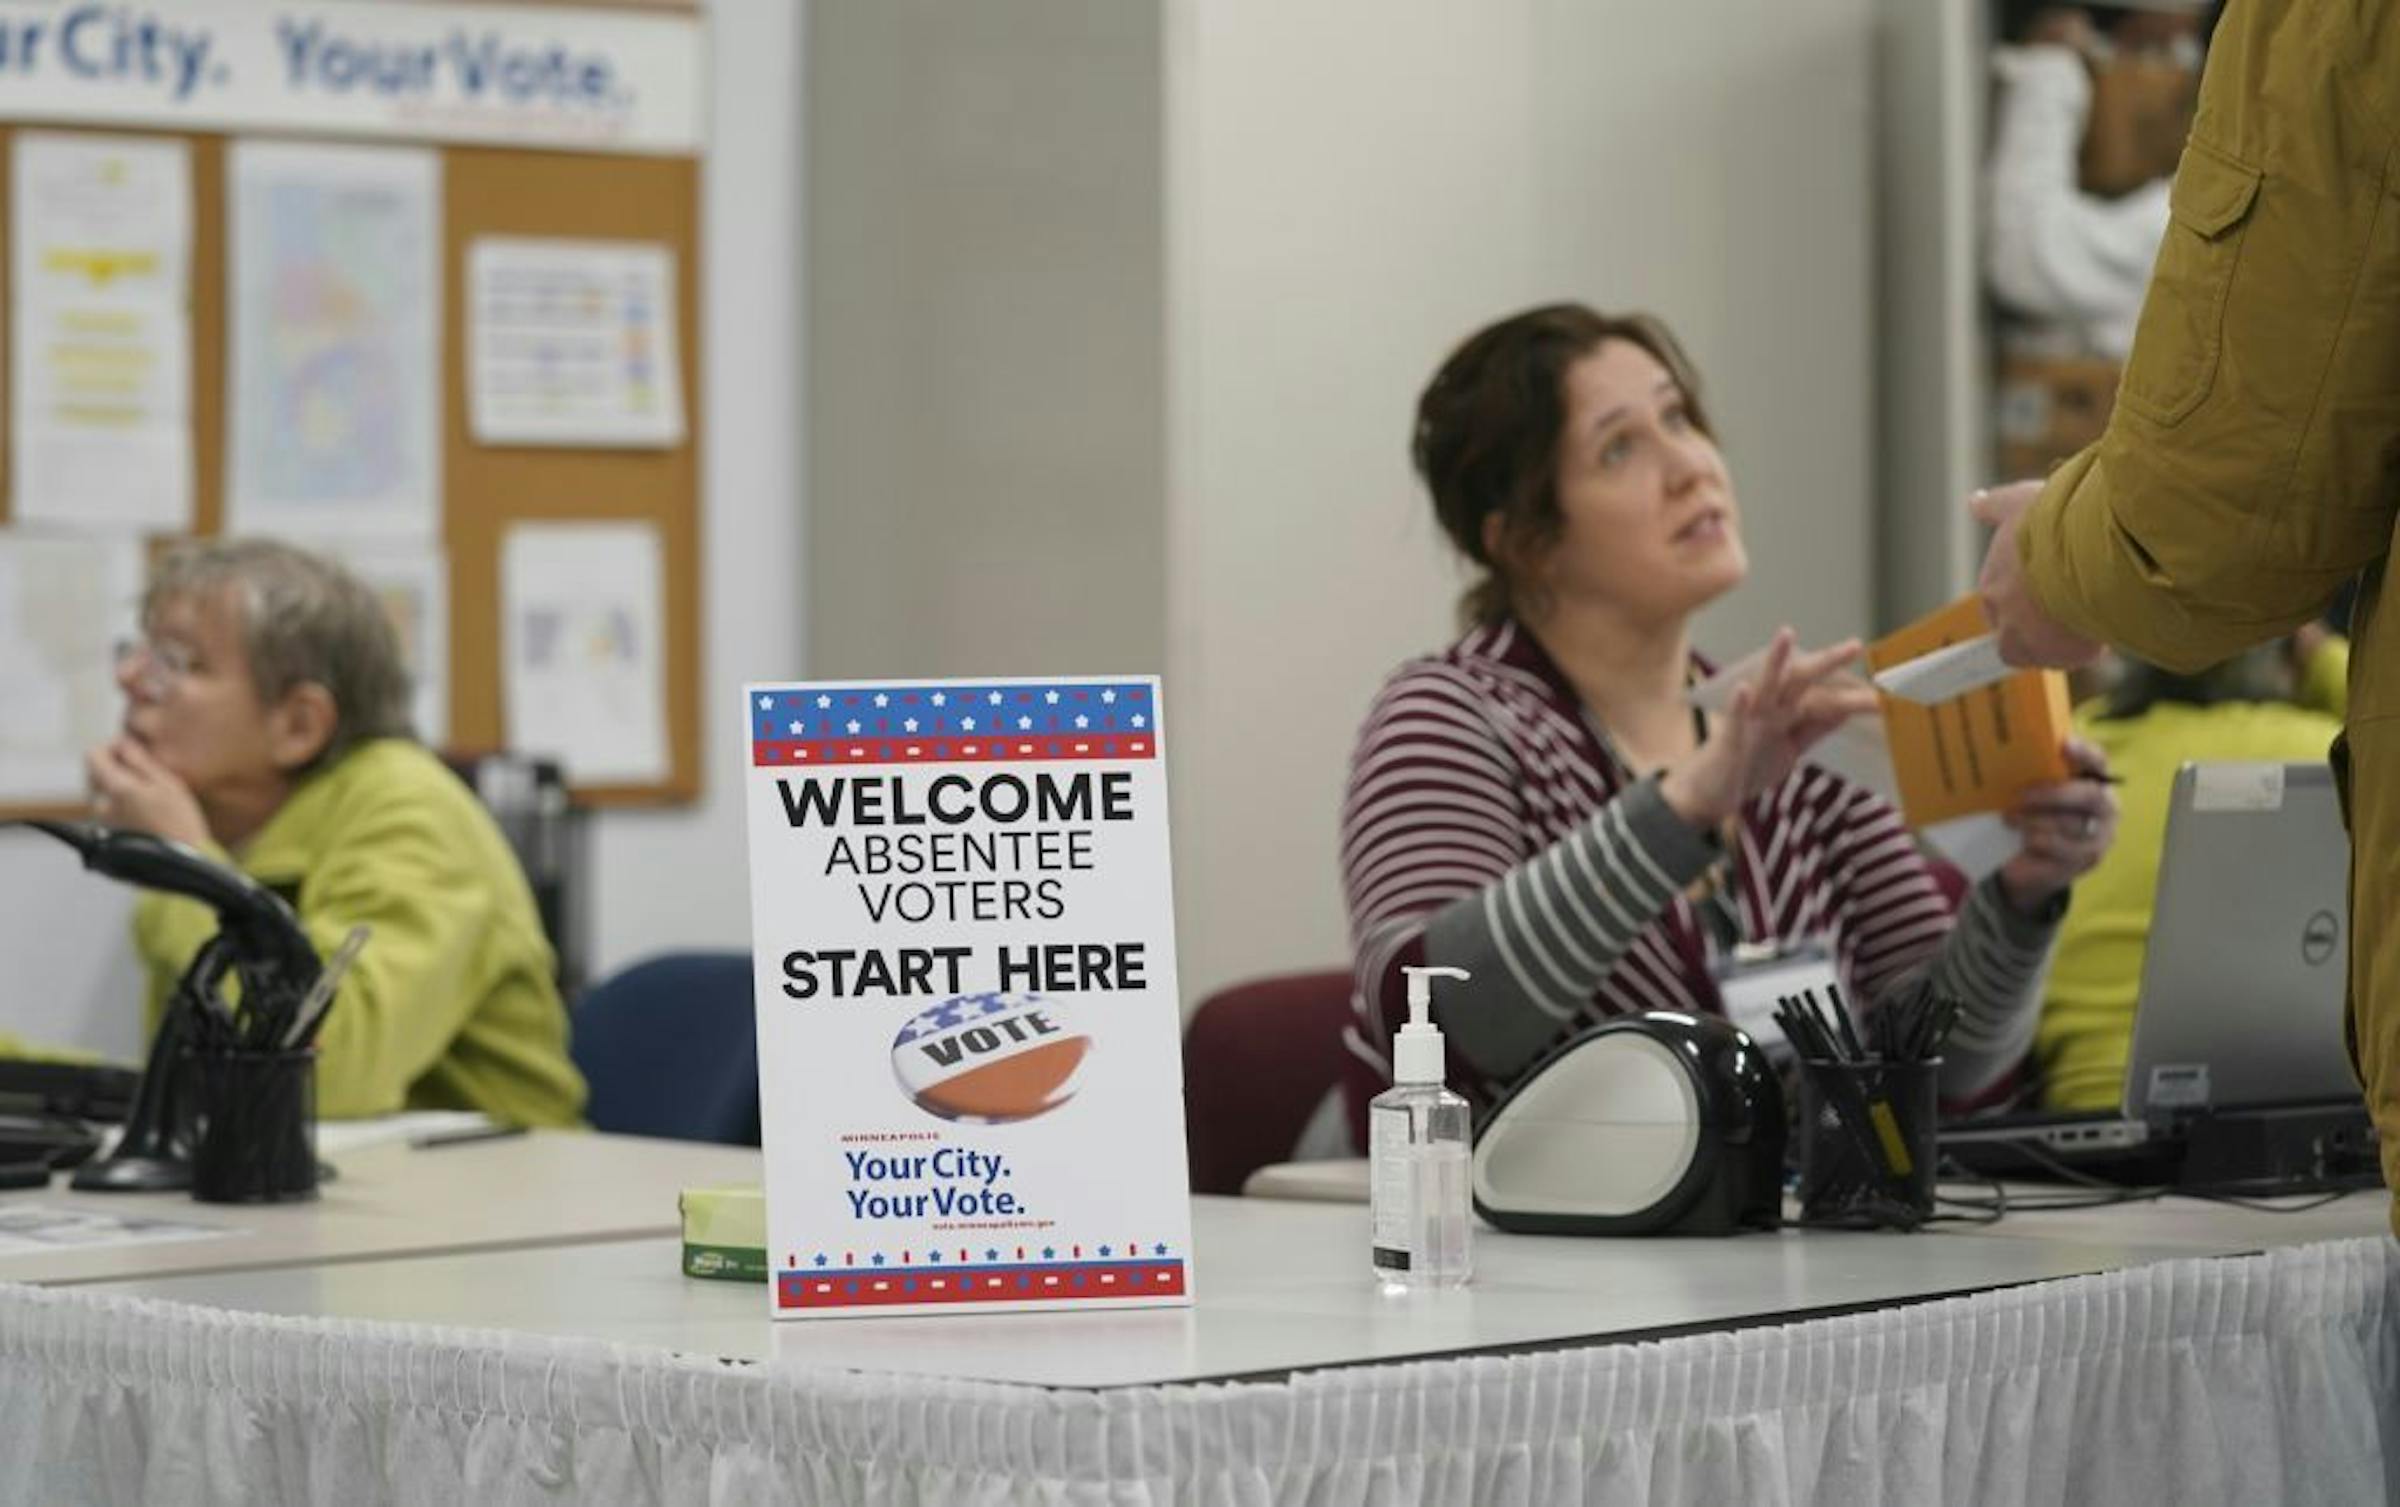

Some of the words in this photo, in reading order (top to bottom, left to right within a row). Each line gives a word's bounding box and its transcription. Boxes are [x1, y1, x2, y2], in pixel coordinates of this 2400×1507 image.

[60, 4, 230, 101] City.
[276, 17, 436, 93] Your
[448, 28, 638, 106] Vote.
[776, 772, 1134, 828] WELCOME
[824, 829, 1095, 876] ABSENTEE
[857, 879, 1065, 924] VOTERS
[782, 946, 973, 1000] START
[998, 943, 1147, 993] HERE
[920, 1010, 1061, 1067] VOTE
[840, 1131, 940, 1143] MINNEAPOLIS
[846, 1151, 926, 1182] Your
[932, 1147, 1011, 1186] City.
[846, 1189, 929, 1219] Your
[931, 1186, 1025, 1216] Vote.
